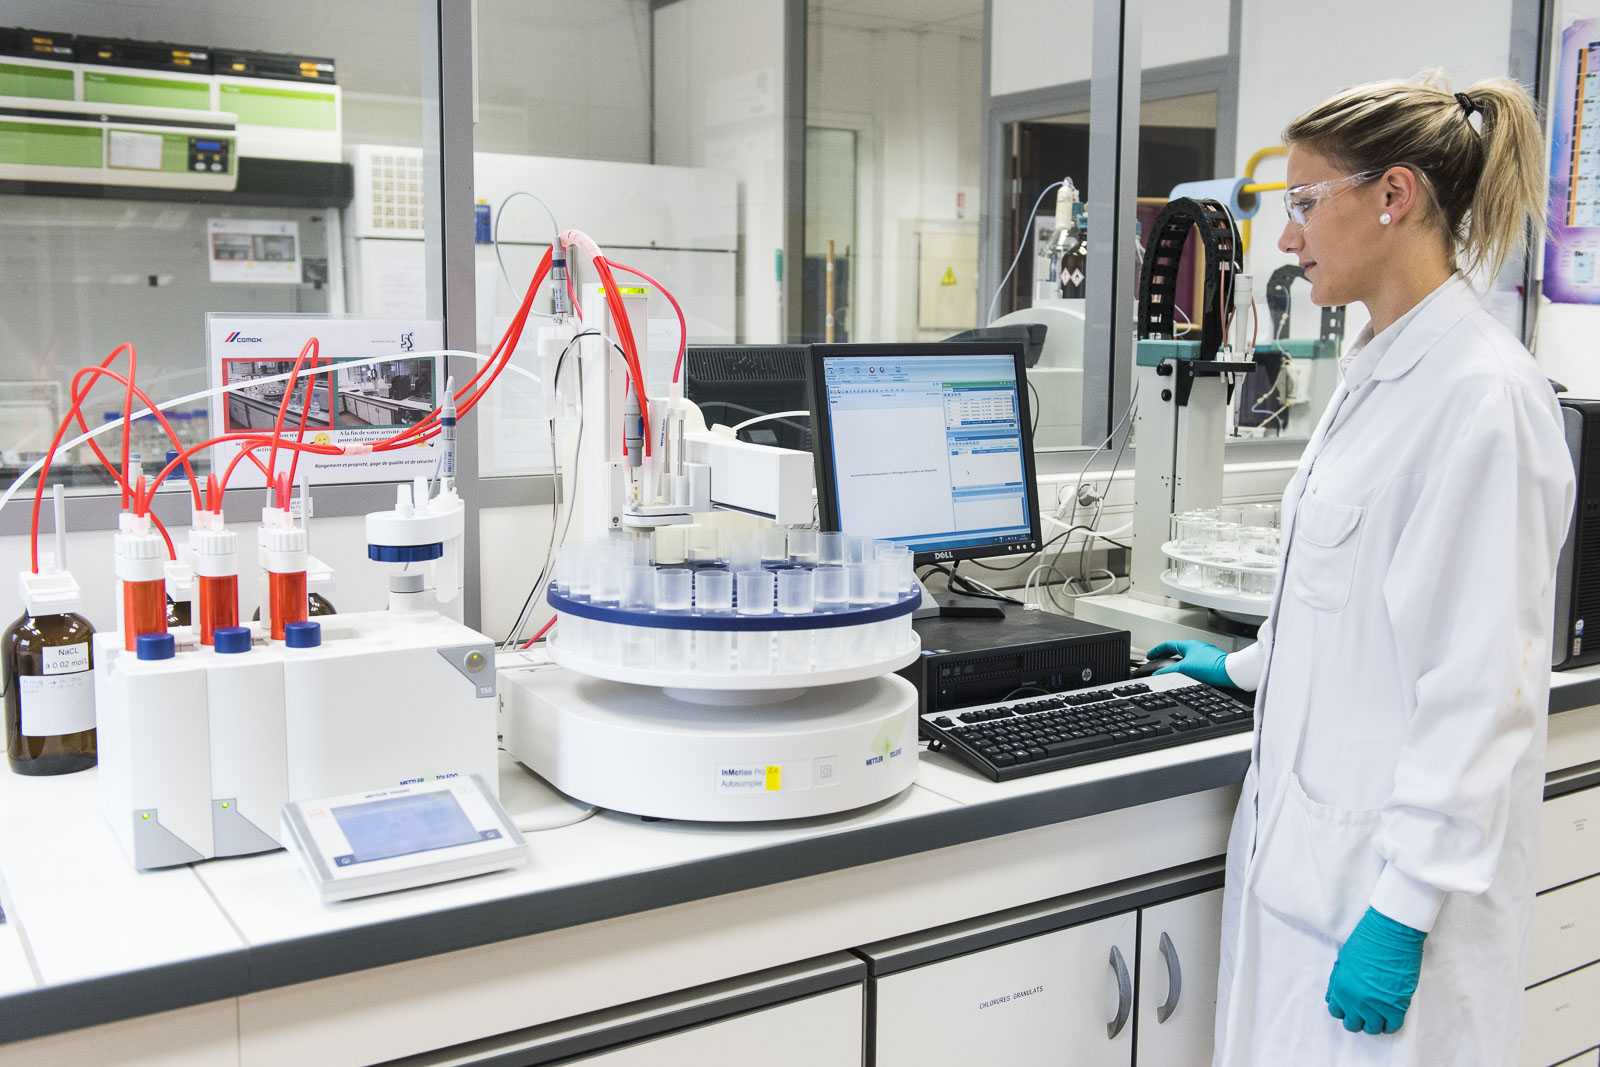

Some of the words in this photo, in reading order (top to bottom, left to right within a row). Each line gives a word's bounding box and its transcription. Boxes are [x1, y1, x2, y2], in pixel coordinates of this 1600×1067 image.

[934, 551, 954, 560] DELL
[979, 996, 1011, 1009] CHLORURES
[1013, 986, 1044, 999] GRANULATS
